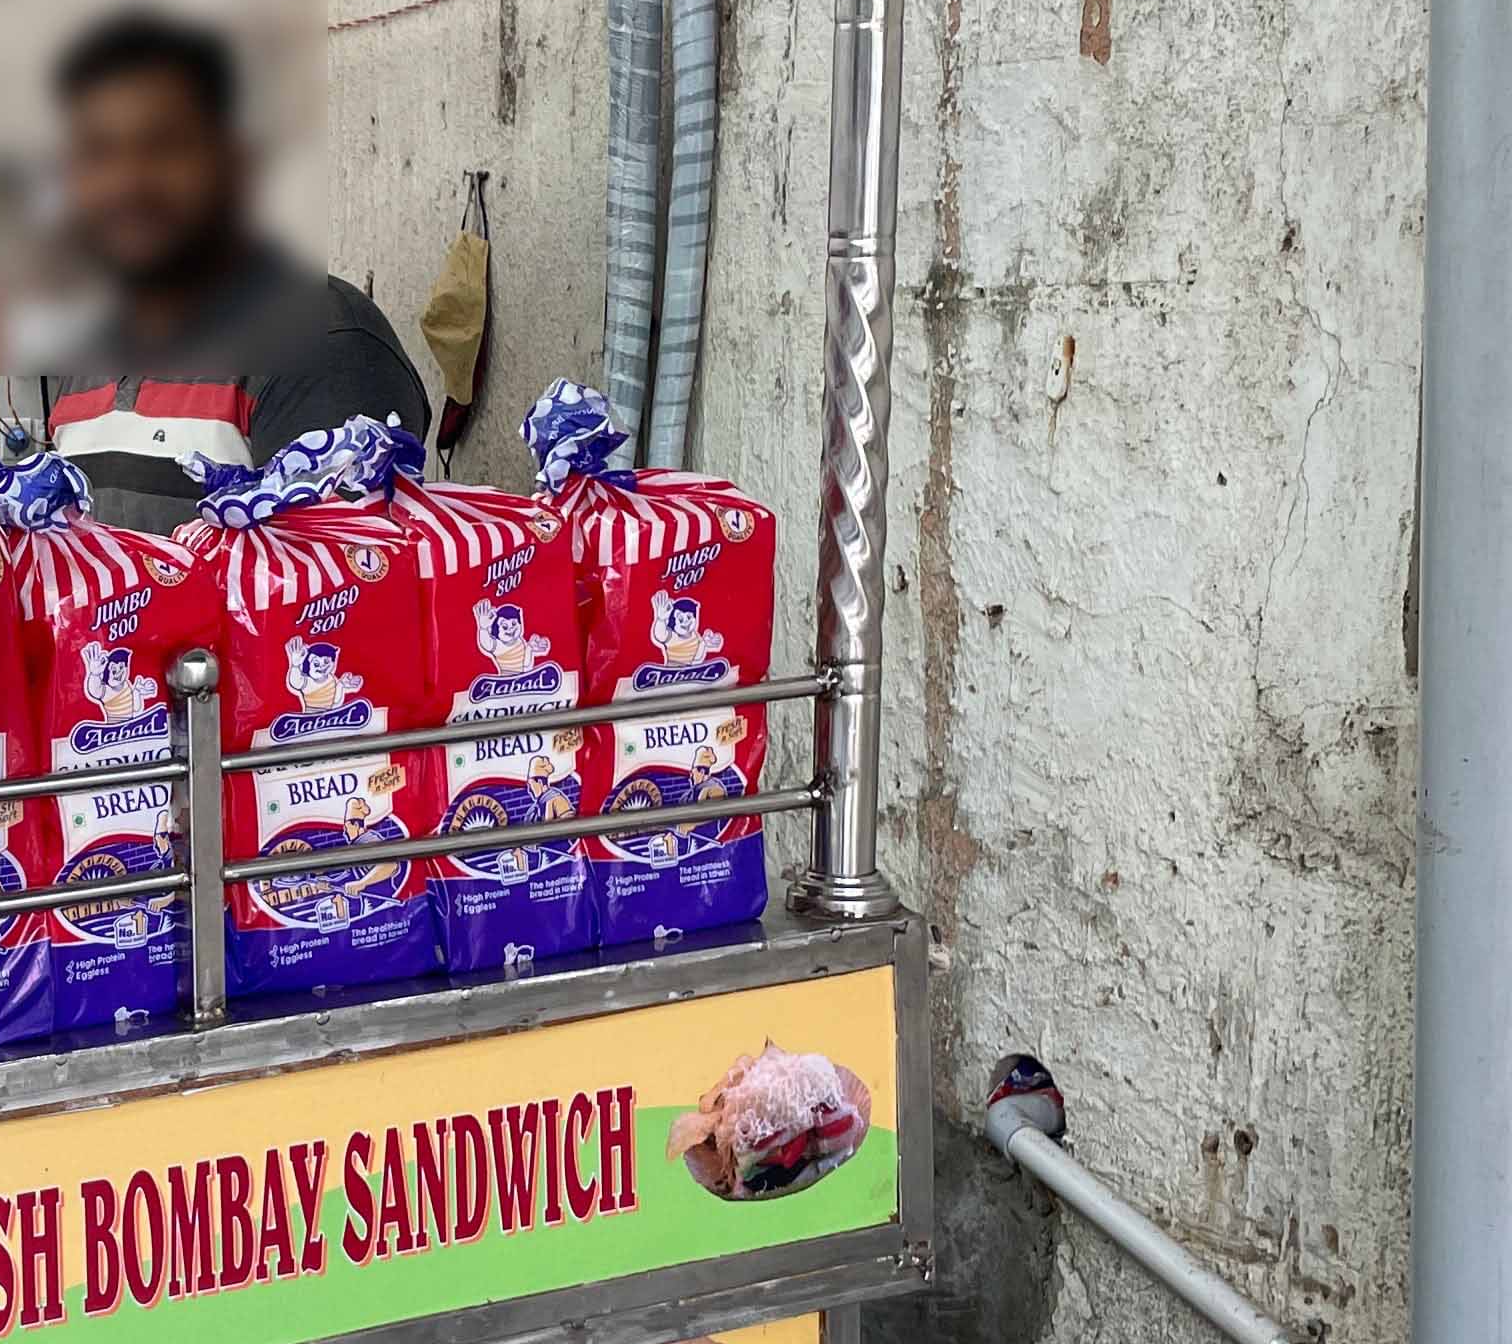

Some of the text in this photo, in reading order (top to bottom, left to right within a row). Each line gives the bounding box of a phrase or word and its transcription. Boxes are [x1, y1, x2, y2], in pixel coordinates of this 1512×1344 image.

[482, 545, 536, 588] JUMBO
[661, 543, 721, 580] JUMBO
[496, 571, 522, 596] 800
[674, 567, 704, 590] 800
[91, 588, 152, 631] JUMBO
[296, 584, 360, 626] JUMBO
[108, 615, 139, 641] 800
[310, 611, 346, 635] 800
[475, 670, 556, 700] Aabad
[80, 713, 168, 750] Aabad
[277, 706, 365, 738] Aabad
[475, 733, 543, 762] BREAD
[643, 722, 708, 750] BREAD
[92, 784, 169, 819] BREAD
[287, 773, 359, 806] BREAD
[615, 871, 660, 887] High Protein
[616, 883, 645, 897] Eggless
[463, 894, 484, 904] High
[463, 901, 497, 915] Eggless
[351, 928, 367, 936] The
[351, 934, 378, 946] bread
[280, 936, 330, 955] High Protein
[280, 950, 313, 966] Eggless
[76, 952, 126, 971] High Protein
[76, 966, 110, 982] Eggless
[80, 1139, 329, 1316] BOMBAY
[342, 1085, 639, 1266] SANDWICH
